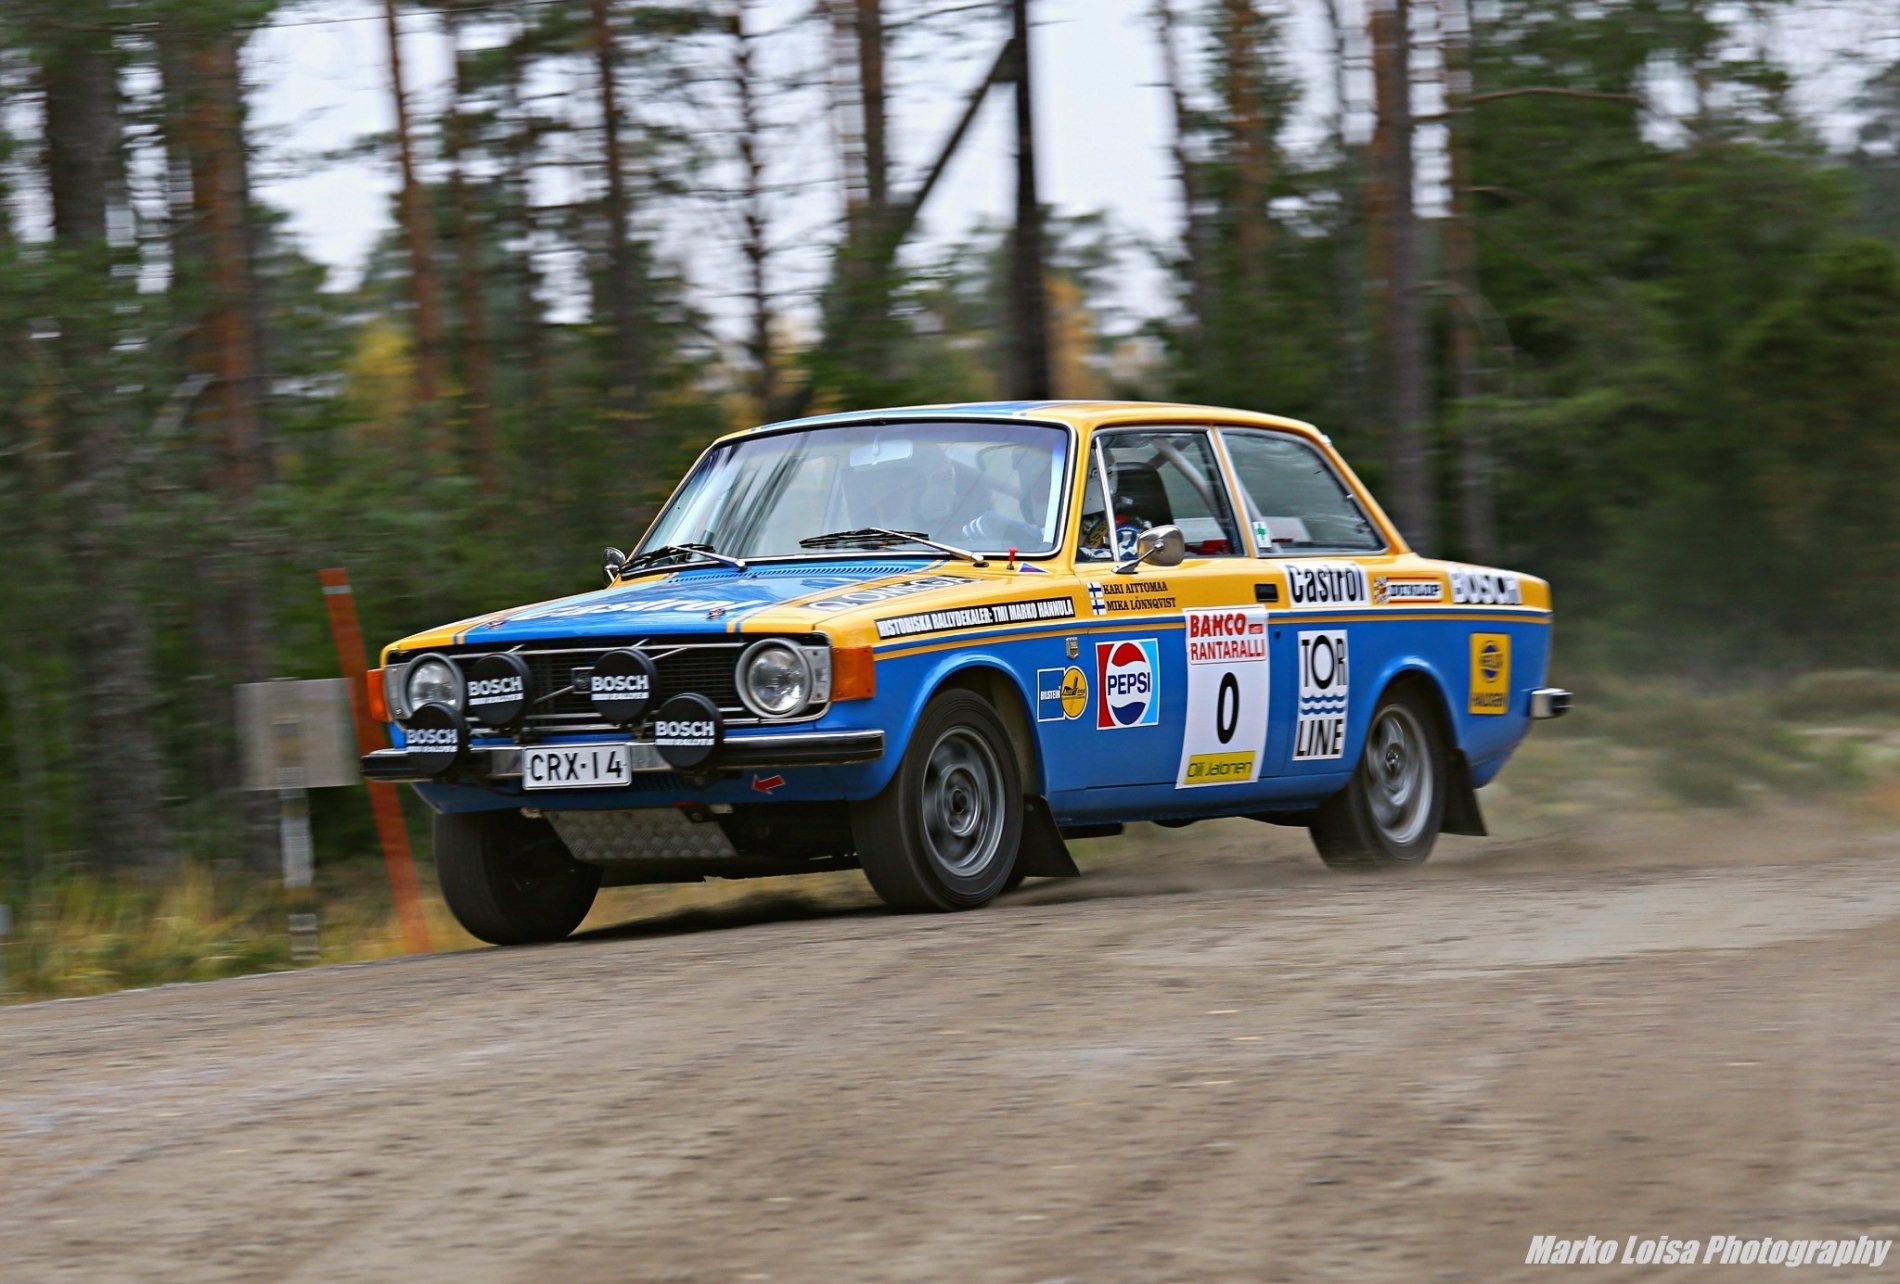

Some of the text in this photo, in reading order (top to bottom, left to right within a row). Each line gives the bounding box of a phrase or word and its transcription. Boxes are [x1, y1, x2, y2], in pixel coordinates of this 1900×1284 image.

[1102, 581, 1168, 595] KARI AITTOMAA
[1285, 563, 1364, 603] Castrol
[1106, 597, 1177, 611] MIKA LÖNNQVIST
[876, 599, 1075, 637] HISTORISKA RALLYDEKALER: TMI MARKO HANNULA
[1190, 613, 1247, 638] BAHCO
[1190, 639, 1266, 661] RANTARALLI
[1302, 634, 1347, 690] TOR
[467, 675, 523, 697] BOSCH
[591, 674, 649, 692] BOSCH
[1107, 671, 1151, 696] PEPSI
[1216, 671, 1240, 745] 0
[406, 728, 458, 744] BOSCH
[655, 720, 715, 737] BOSCH
[1296, 718, 1343, 757] LINE
[531, 750, 623, 781] CRX-14
